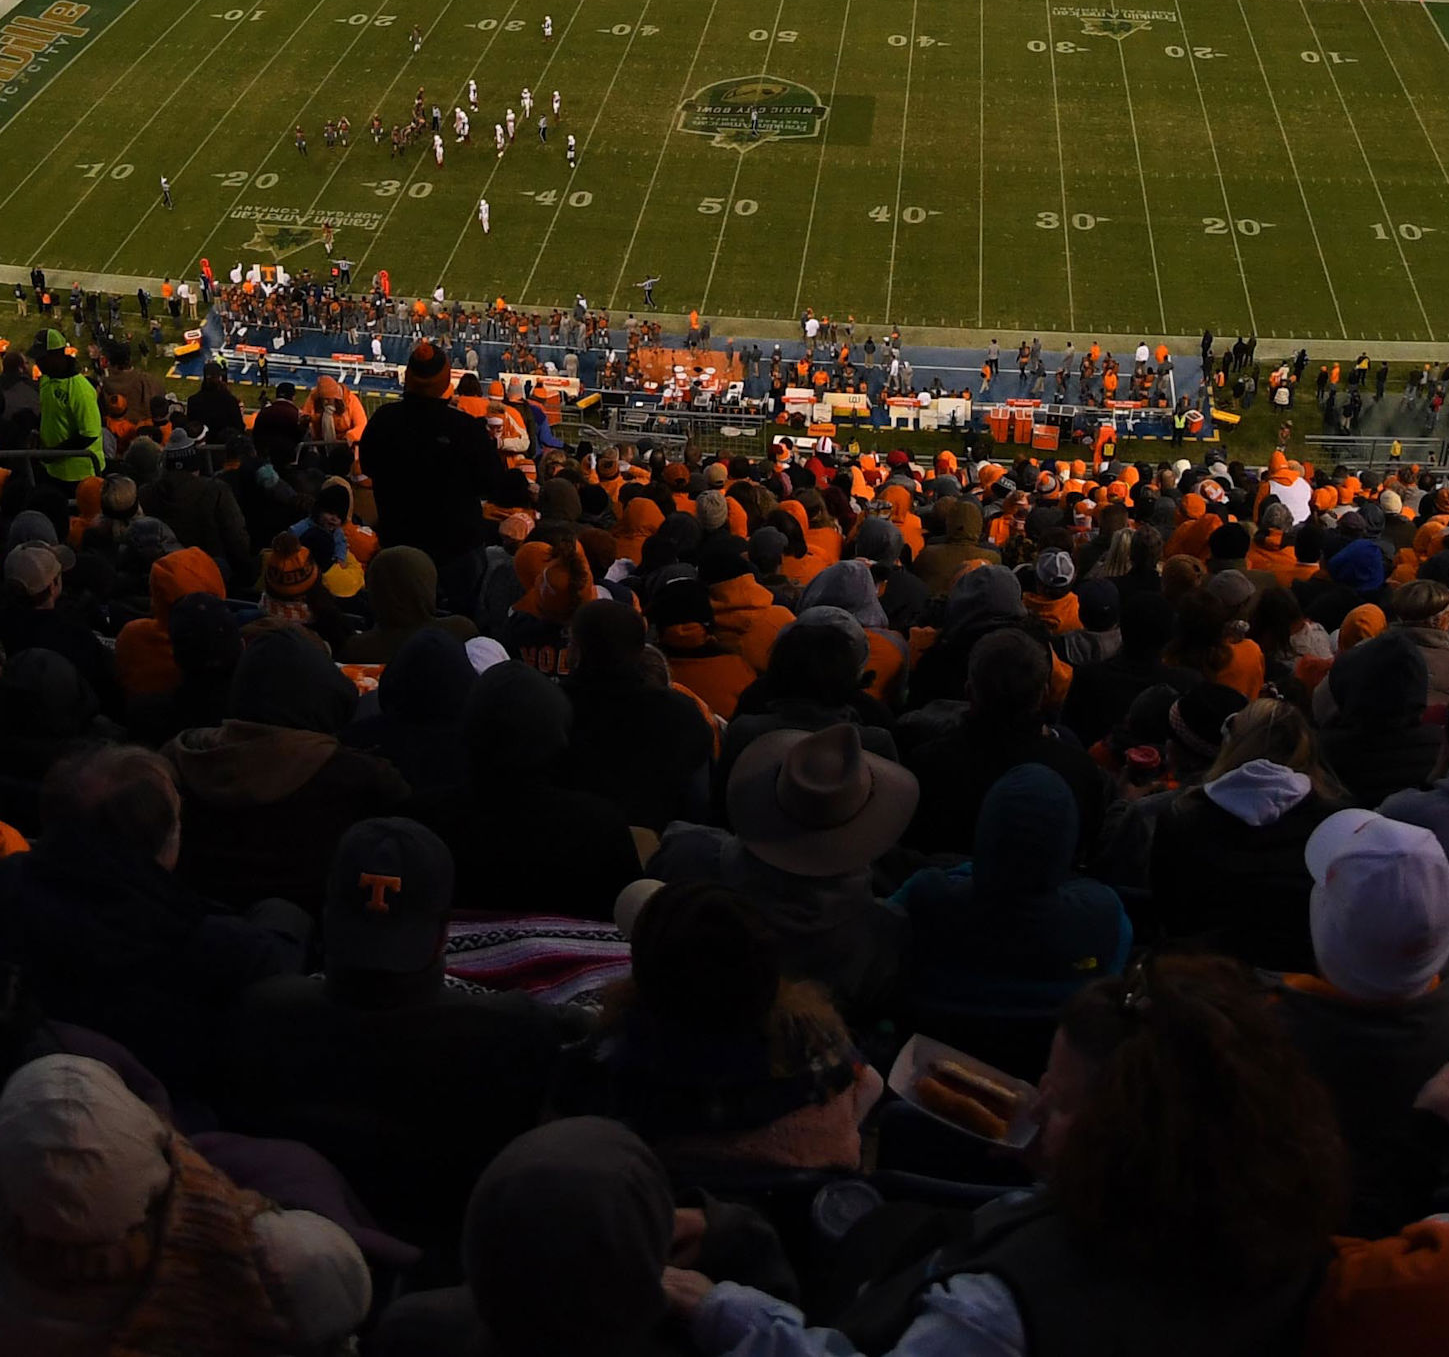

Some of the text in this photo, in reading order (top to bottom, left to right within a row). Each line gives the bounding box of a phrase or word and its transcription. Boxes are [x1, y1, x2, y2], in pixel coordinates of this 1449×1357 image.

[26, 36, 70, 74] CITY
[83, 162, 135, 180] 10
[220, 171, 279, 189] 20
[374, 180, 433, 199] 30
[534, 189, 593, 207] 40
[697, 197, 759, 216] 50
[867, 205, 926, 224] 40
[229, 210, 381, 230] Franklin American
[1035, 212, 1096, 231] 30
[1201, 217, 1261, 236] 20
[1369, 222, 1423, 241] 10
[261, 266, 276, 283] T
[358, 871, 402, 915] T
